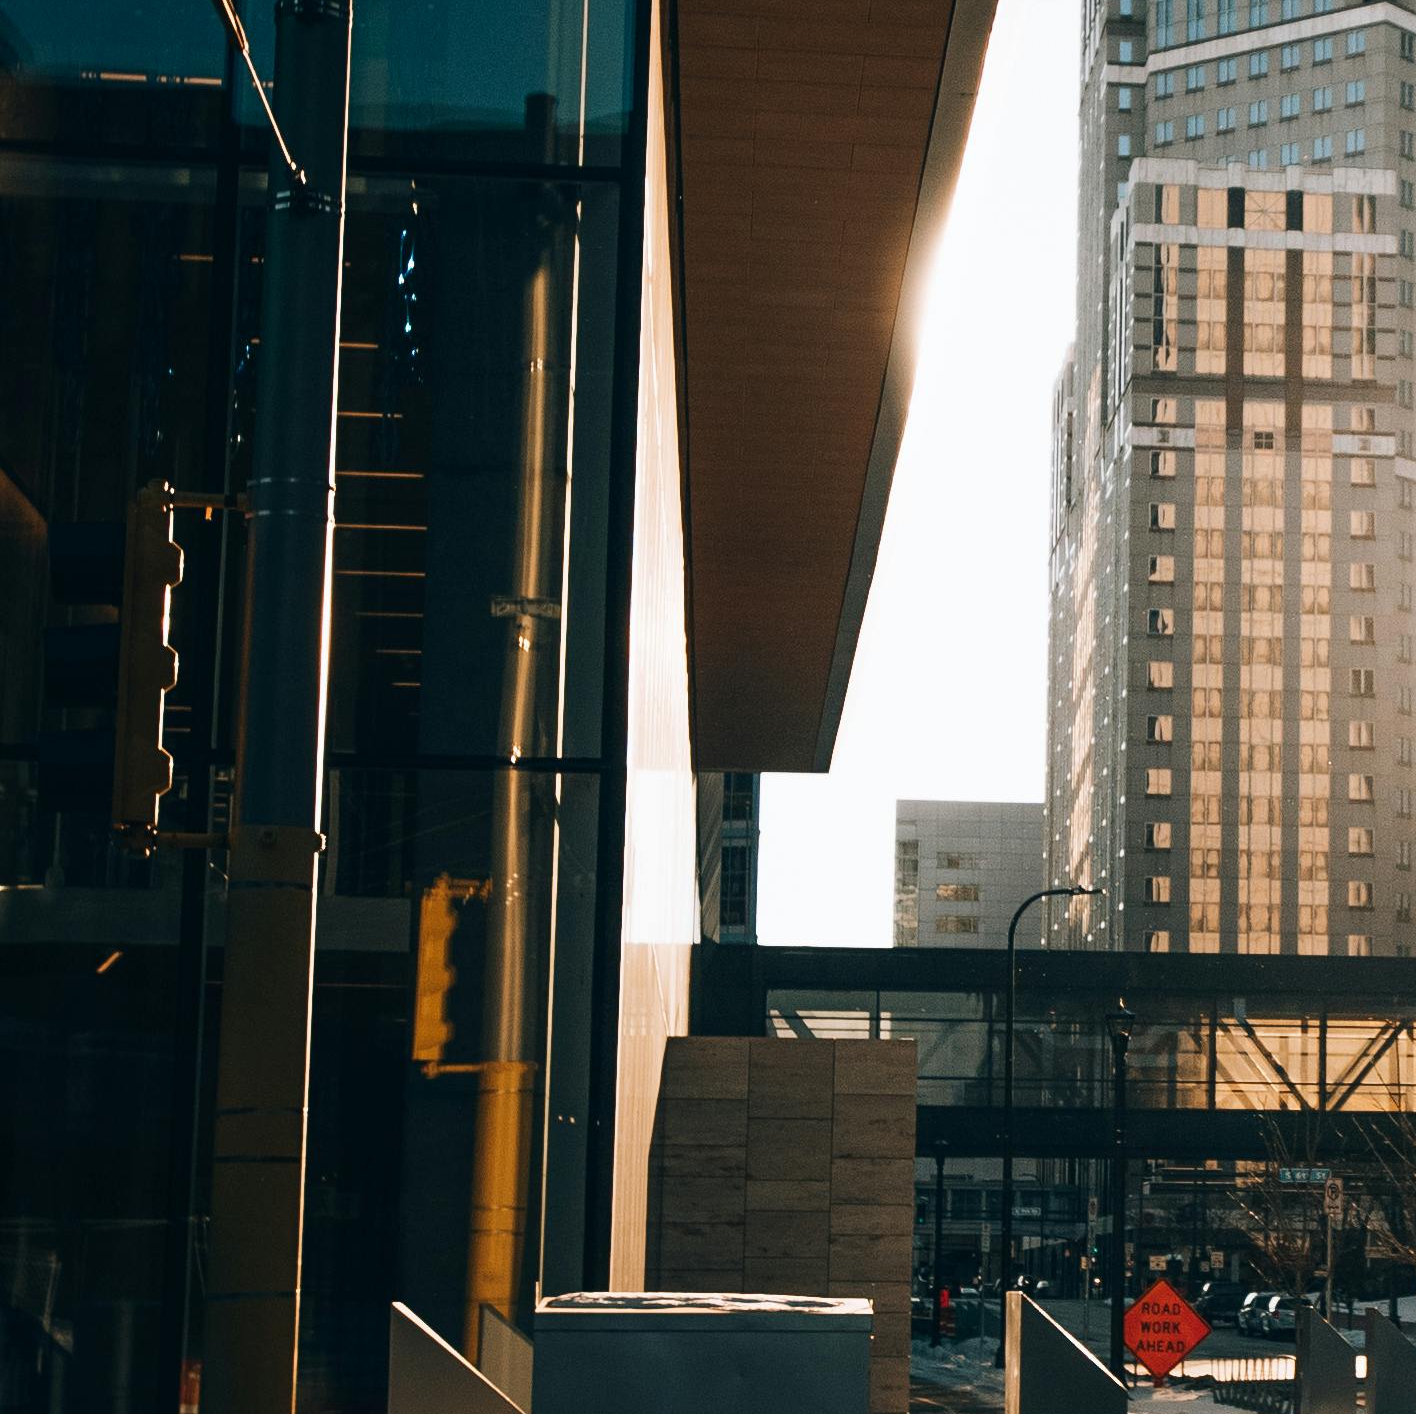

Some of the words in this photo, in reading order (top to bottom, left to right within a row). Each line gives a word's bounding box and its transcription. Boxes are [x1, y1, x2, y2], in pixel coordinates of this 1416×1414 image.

[1141, 1302, 1181, 1315] ROAD
[1141, 1321, 1181, 1334] WORK
[1136, 1339, 1185, 1353] AHEAD
